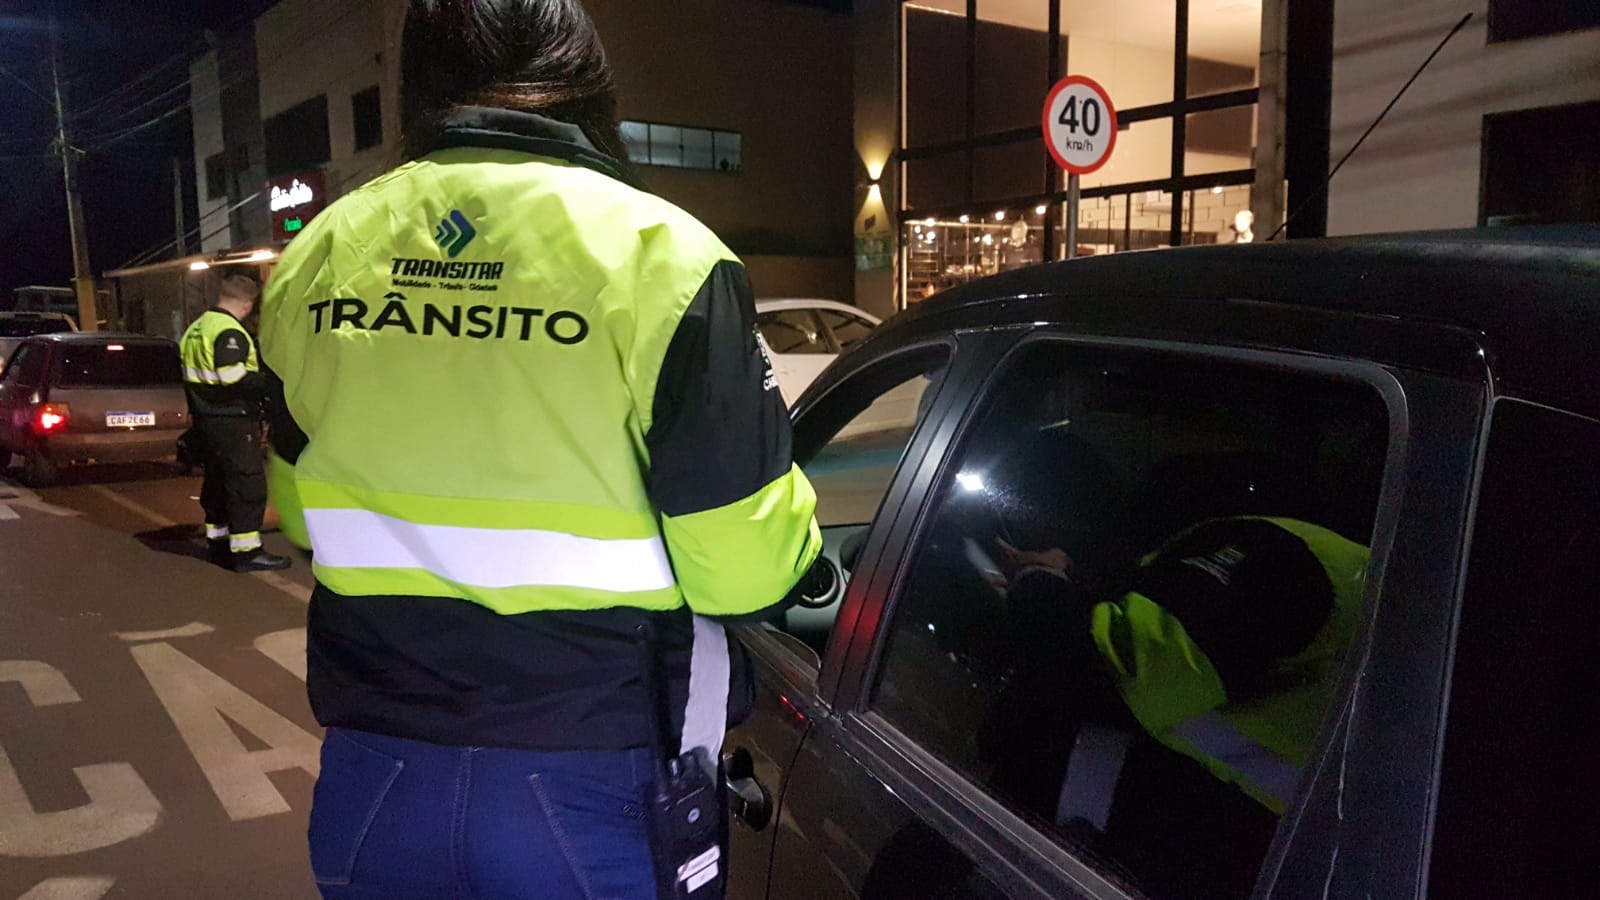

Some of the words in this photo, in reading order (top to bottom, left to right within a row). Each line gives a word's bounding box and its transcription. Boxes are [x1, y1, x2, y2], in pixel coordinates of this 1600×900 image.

[1058, 95, 1100, 136] 40
[1066, 137, 1093, 152] km/h
[391, 258, 504, 280] TRANSITAR
[308, 292, 590, 345] TRÂNSITO
